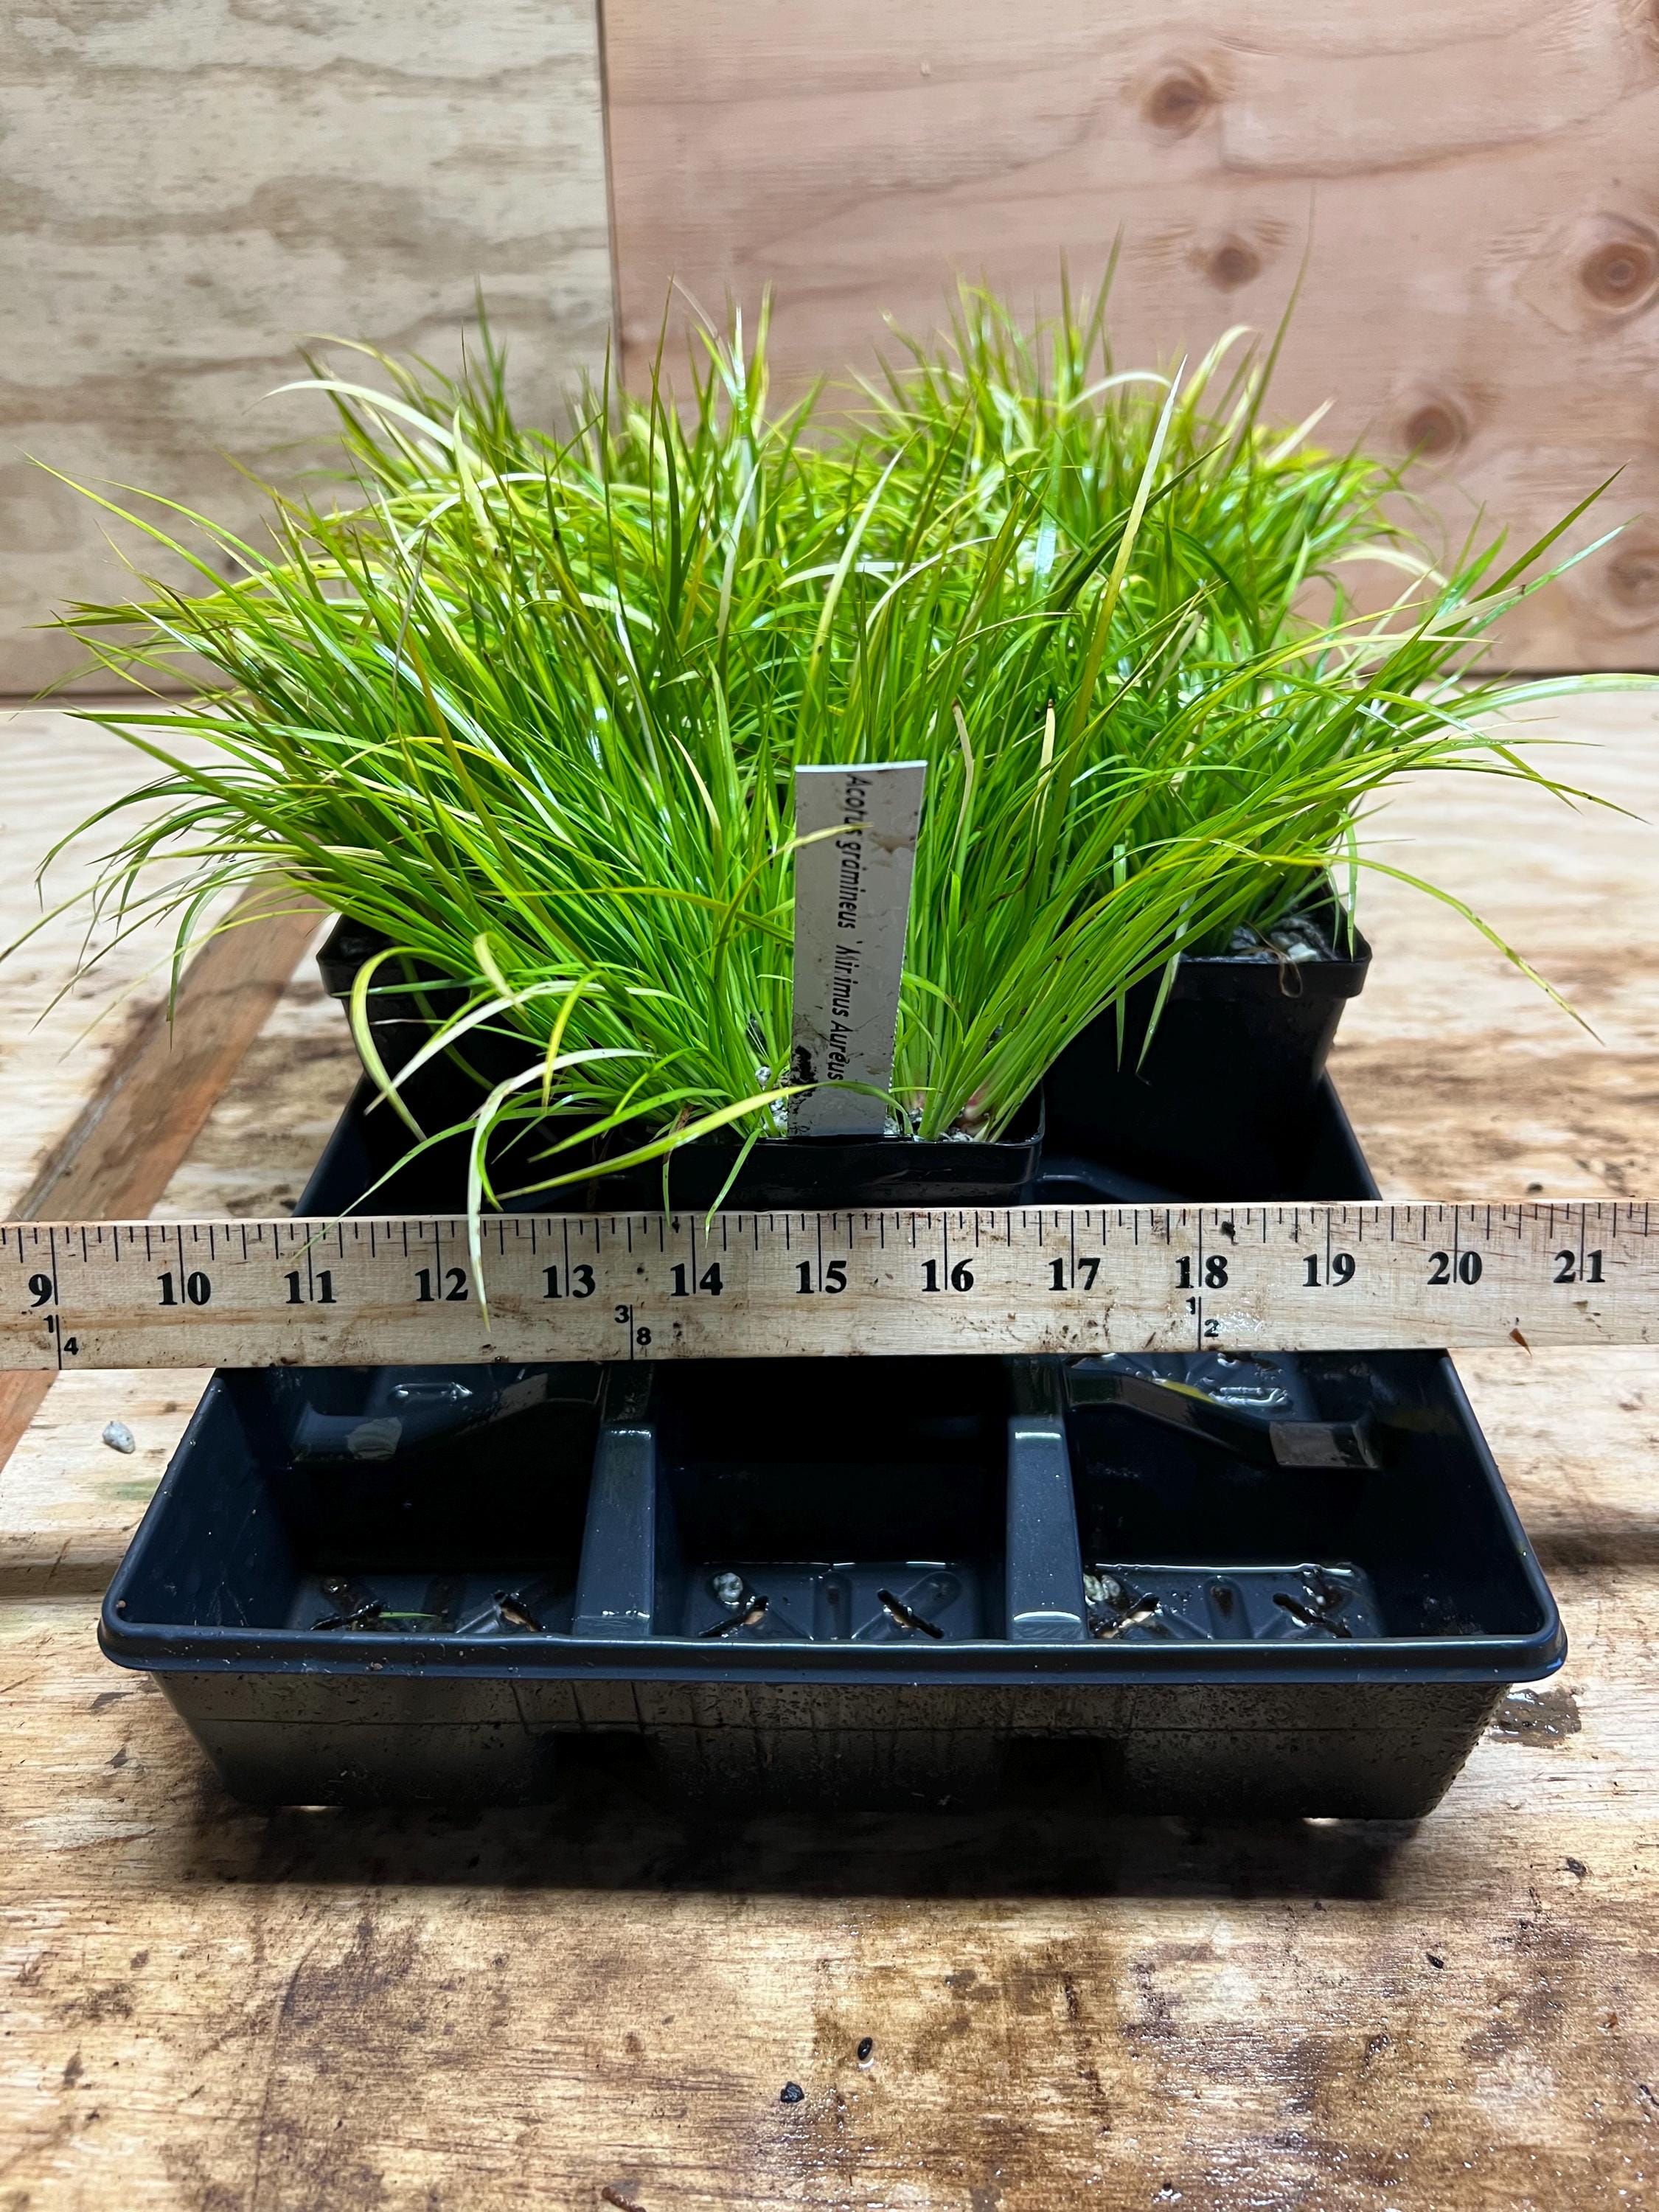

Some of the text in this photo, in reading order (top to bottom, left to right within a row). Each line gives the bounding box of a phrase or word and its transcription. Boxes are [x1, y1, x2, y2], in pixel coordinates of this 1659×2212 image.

[835, 840, 866, 930] gramineus
[28, 1250, 1606, 1308] 9 10 11 12 13 14 15 16 17 18 19 20 21
